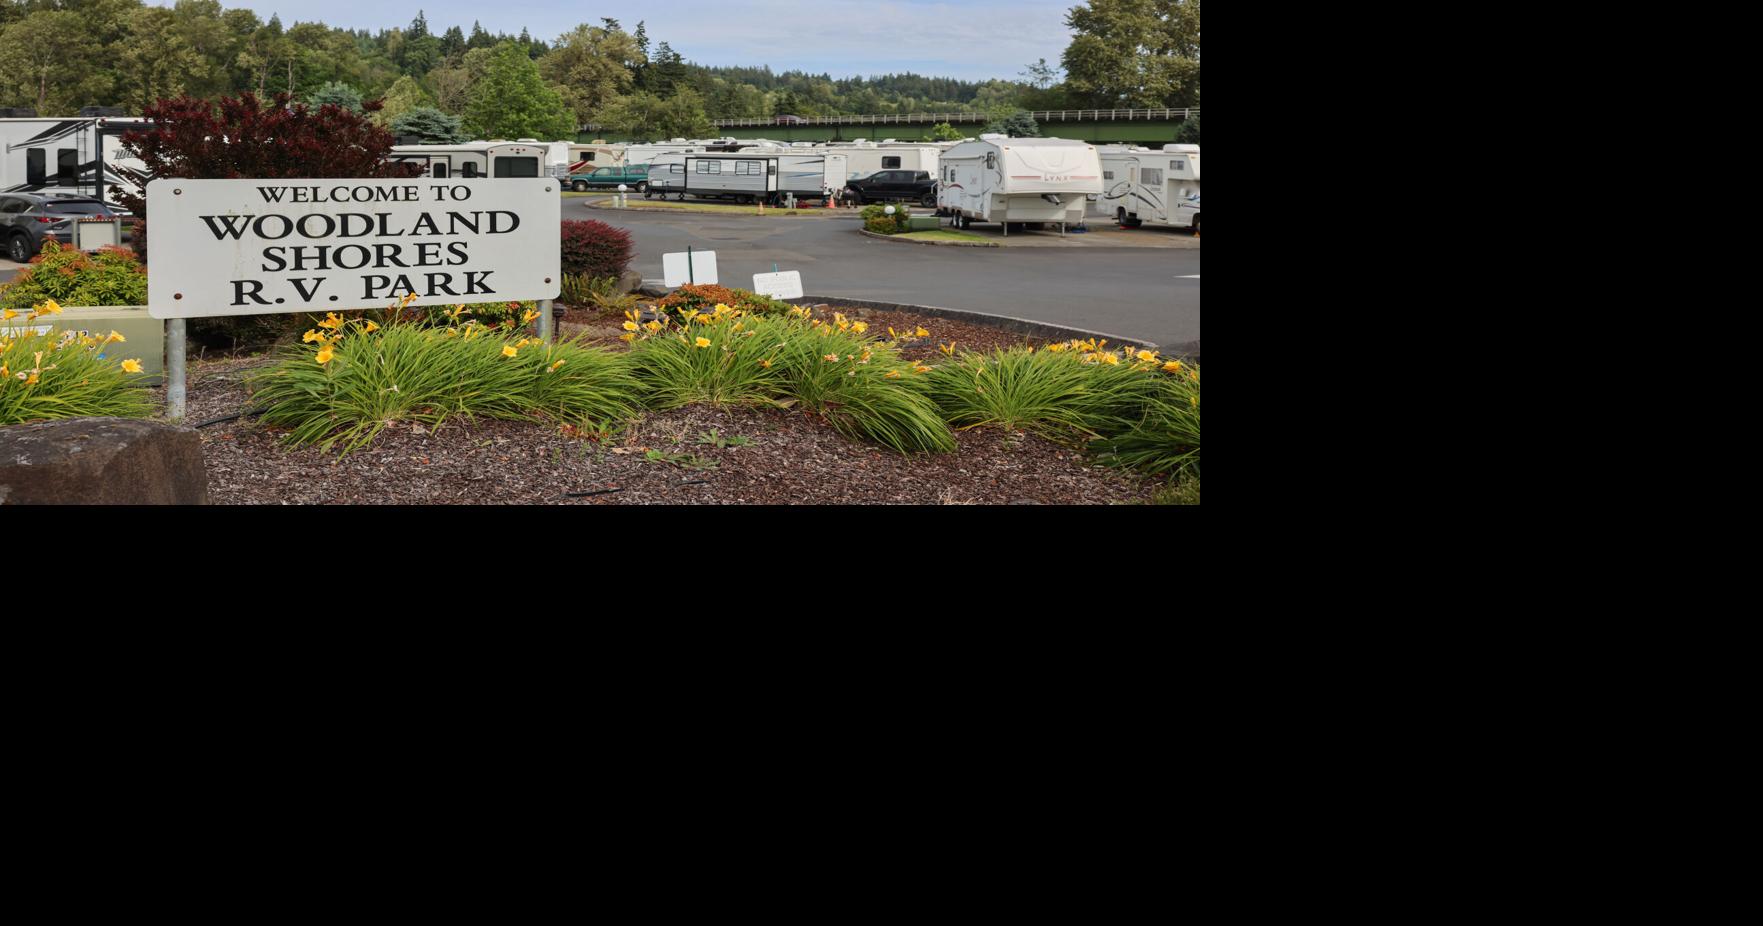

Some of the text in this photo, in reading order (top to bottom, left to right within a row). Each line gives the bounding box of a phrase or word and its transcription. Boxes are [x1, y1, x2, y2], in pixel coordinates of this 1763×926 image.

[256, 185, 472, 203] WELCOME TO
[199, 210, 521, 240] WOODLAND
[261, 241, 469, 272] SHORES
[230, 270, 496, 306] R.V. PARK
